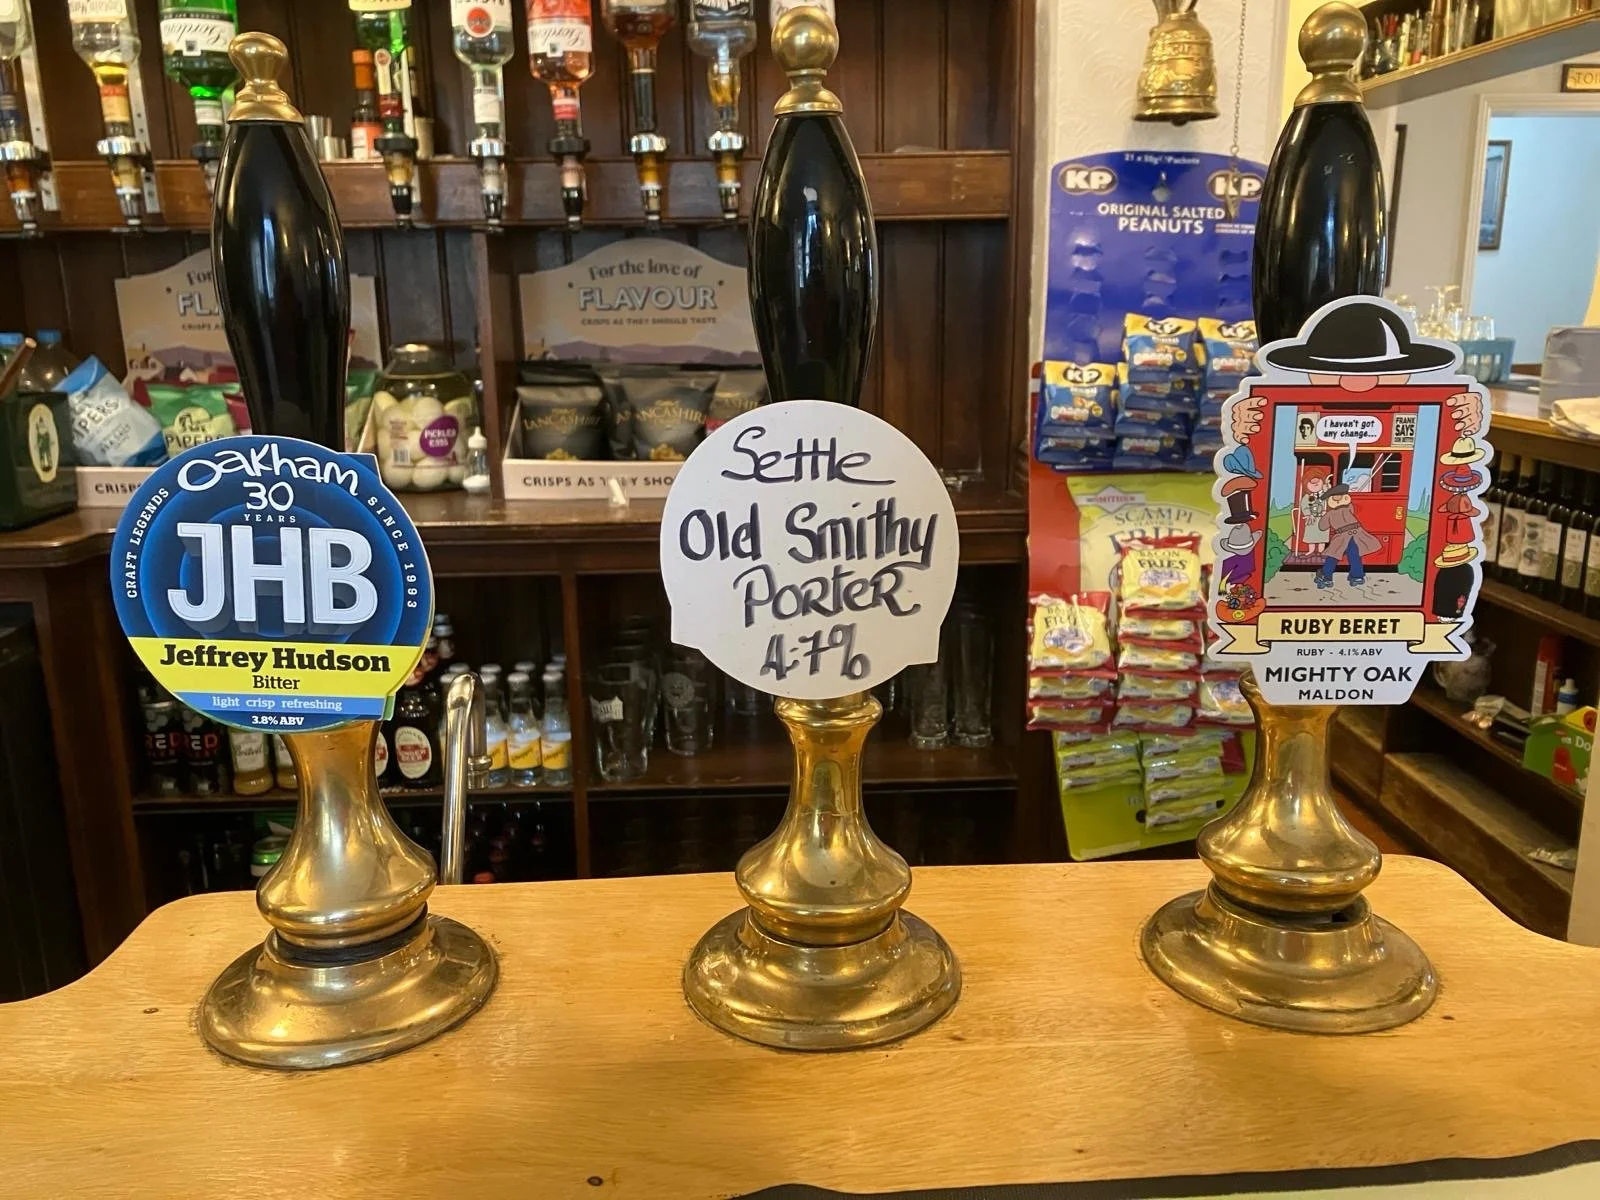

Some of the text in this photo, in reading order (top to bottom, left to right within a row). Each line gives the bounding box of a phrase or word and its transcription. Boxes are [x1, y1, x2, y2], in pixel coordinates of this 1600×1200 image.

[1064, 170, 1113, 190] KP
[1214, 176, 1262, 196] KP
[1097, 203, 1226, 220] ORIGINAL SALTED
[1118, 217, 1205, 234] PEANUTS
[588, 258, 703, 281] For the love of
[177, 292, 220, 316] FL
[578, 286, 719, 311] FLAVOUR
[652, 317, 688, 325] SHOULD
[1066, 368, 1100, 382] KP
[1330, 419, 1359, 428] haven't
[1361, 420, 1375, 429] got
[1395, 425, 1415, 436] SAYS
[1324, 431, 1337, 439] any
[720, 425, 897, 486] Settle
[177, 443, 359, 496] Oakham
[523, 476, 572, 487] CRISPS
[577, 476, 595, 487] AS
[600, 476, 638, 487] TEY
[243, 481, 294, 512] 30
[243, 513, 297, 524] YEARS
[1114, 507, 1193, 526] SCAMPI
[679, 496, 939, 570] Old Smithy
[125, 487, 170, 599] CRAFT LEGENDS
[367, 496, 418, 608] SINCE 1993
[1138, 559, 1189, 570] FRIES
[166, 522, 378, 625] JHB
[1280, 618, 1401, 635] RUBY BERET
[160, 644, 391, 672] Jeffrey Hudson
[1297, 648, 1325, 656] RUBY
[252, 675, 300, 691] Bitter
[1265, 666, 1413, 683] MIGHTY OAK
[1298, 689, 1374, 700] MALDON
[212, 696, 343, 712] light crisp refreshing
